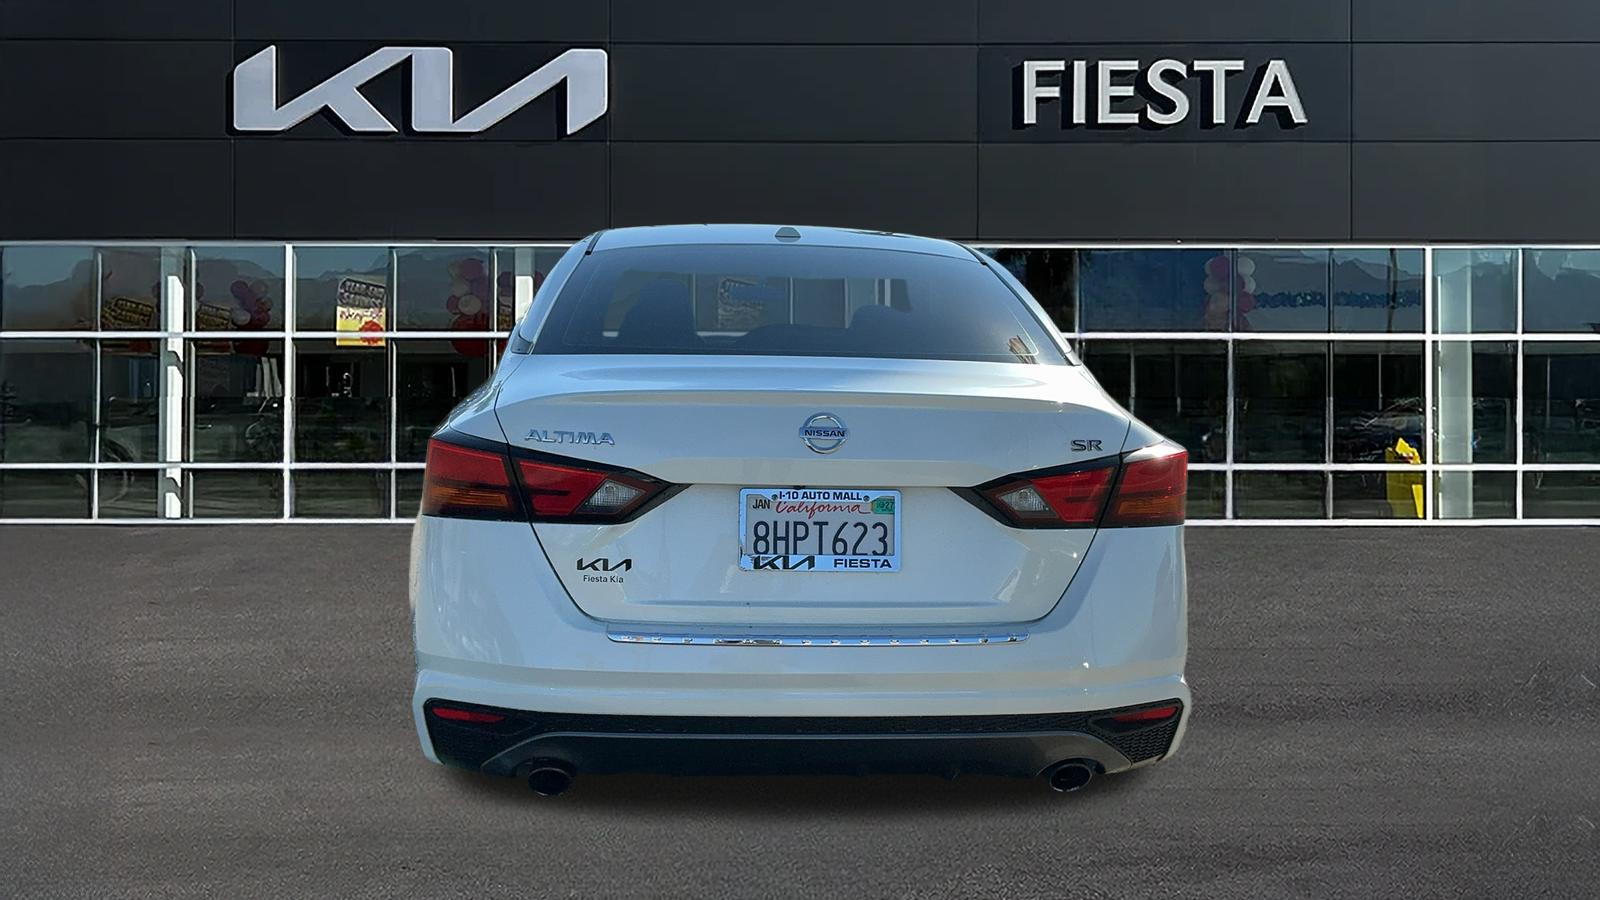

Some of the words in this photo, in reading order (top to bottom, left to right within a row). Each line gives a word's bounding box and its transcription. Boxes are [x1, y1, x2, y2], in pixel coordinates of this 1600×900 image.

[234, 45, 608, 135] KIA
[1023, 59, 1308, 125] FIESTA
[525, 429, 615, 446] ALTIMA
[804, 429, 845, 437] NISSAN
[1071, 439, 1103, 451] SR
[801, 491, 830, 500] AUTO
[833, 492, 862, 501] MALL
[753, 499, 770, 509] JAN
[775, 501, 871, 519] California
[753, 520, 888, 556] 8HPT623
[577, 558, 632, 571] KIA
[753, 555, 816, 570] KIA
[833, 559, 892, 569] FIESTA
[583, 575, 608, 583] Fiesta
